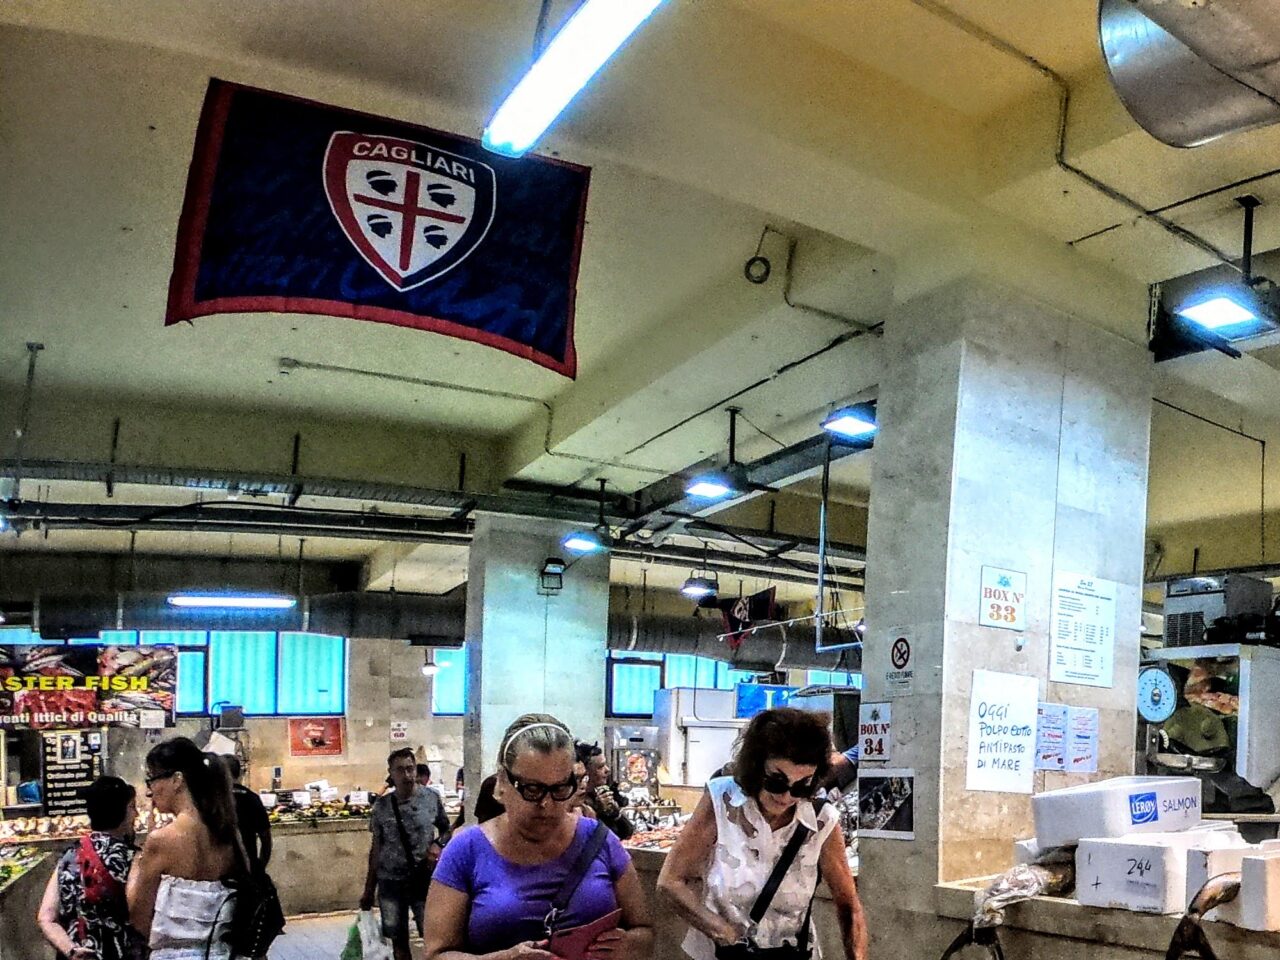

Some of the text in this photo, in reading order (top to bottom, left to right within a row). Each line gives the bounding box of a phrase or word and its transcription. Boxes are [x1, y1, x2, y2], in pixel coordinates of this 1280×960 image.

[353, 142, 475, 183] CAGLIARI
[984, 588, 1009, 601] BOX
[989, 603, 1016, 623] 33
[86, 676, 148, 691] FISH
[0, 711, 29, 723] enti
[34, 711, 67, 722] Ittici
[71, 711, 83, 722] di
[978, 701, 1010, 720] OGGI
[860, 723, 878, 735] BOX
[979, 722, 1009, 737] POLPO
[864, 738, 884, 755] 34
[979, 740, 1026, 754] ANTIPASTO
[977, 757, 1020, 771] DI MARE
[1162, 796, 1197, 812] SALMON
